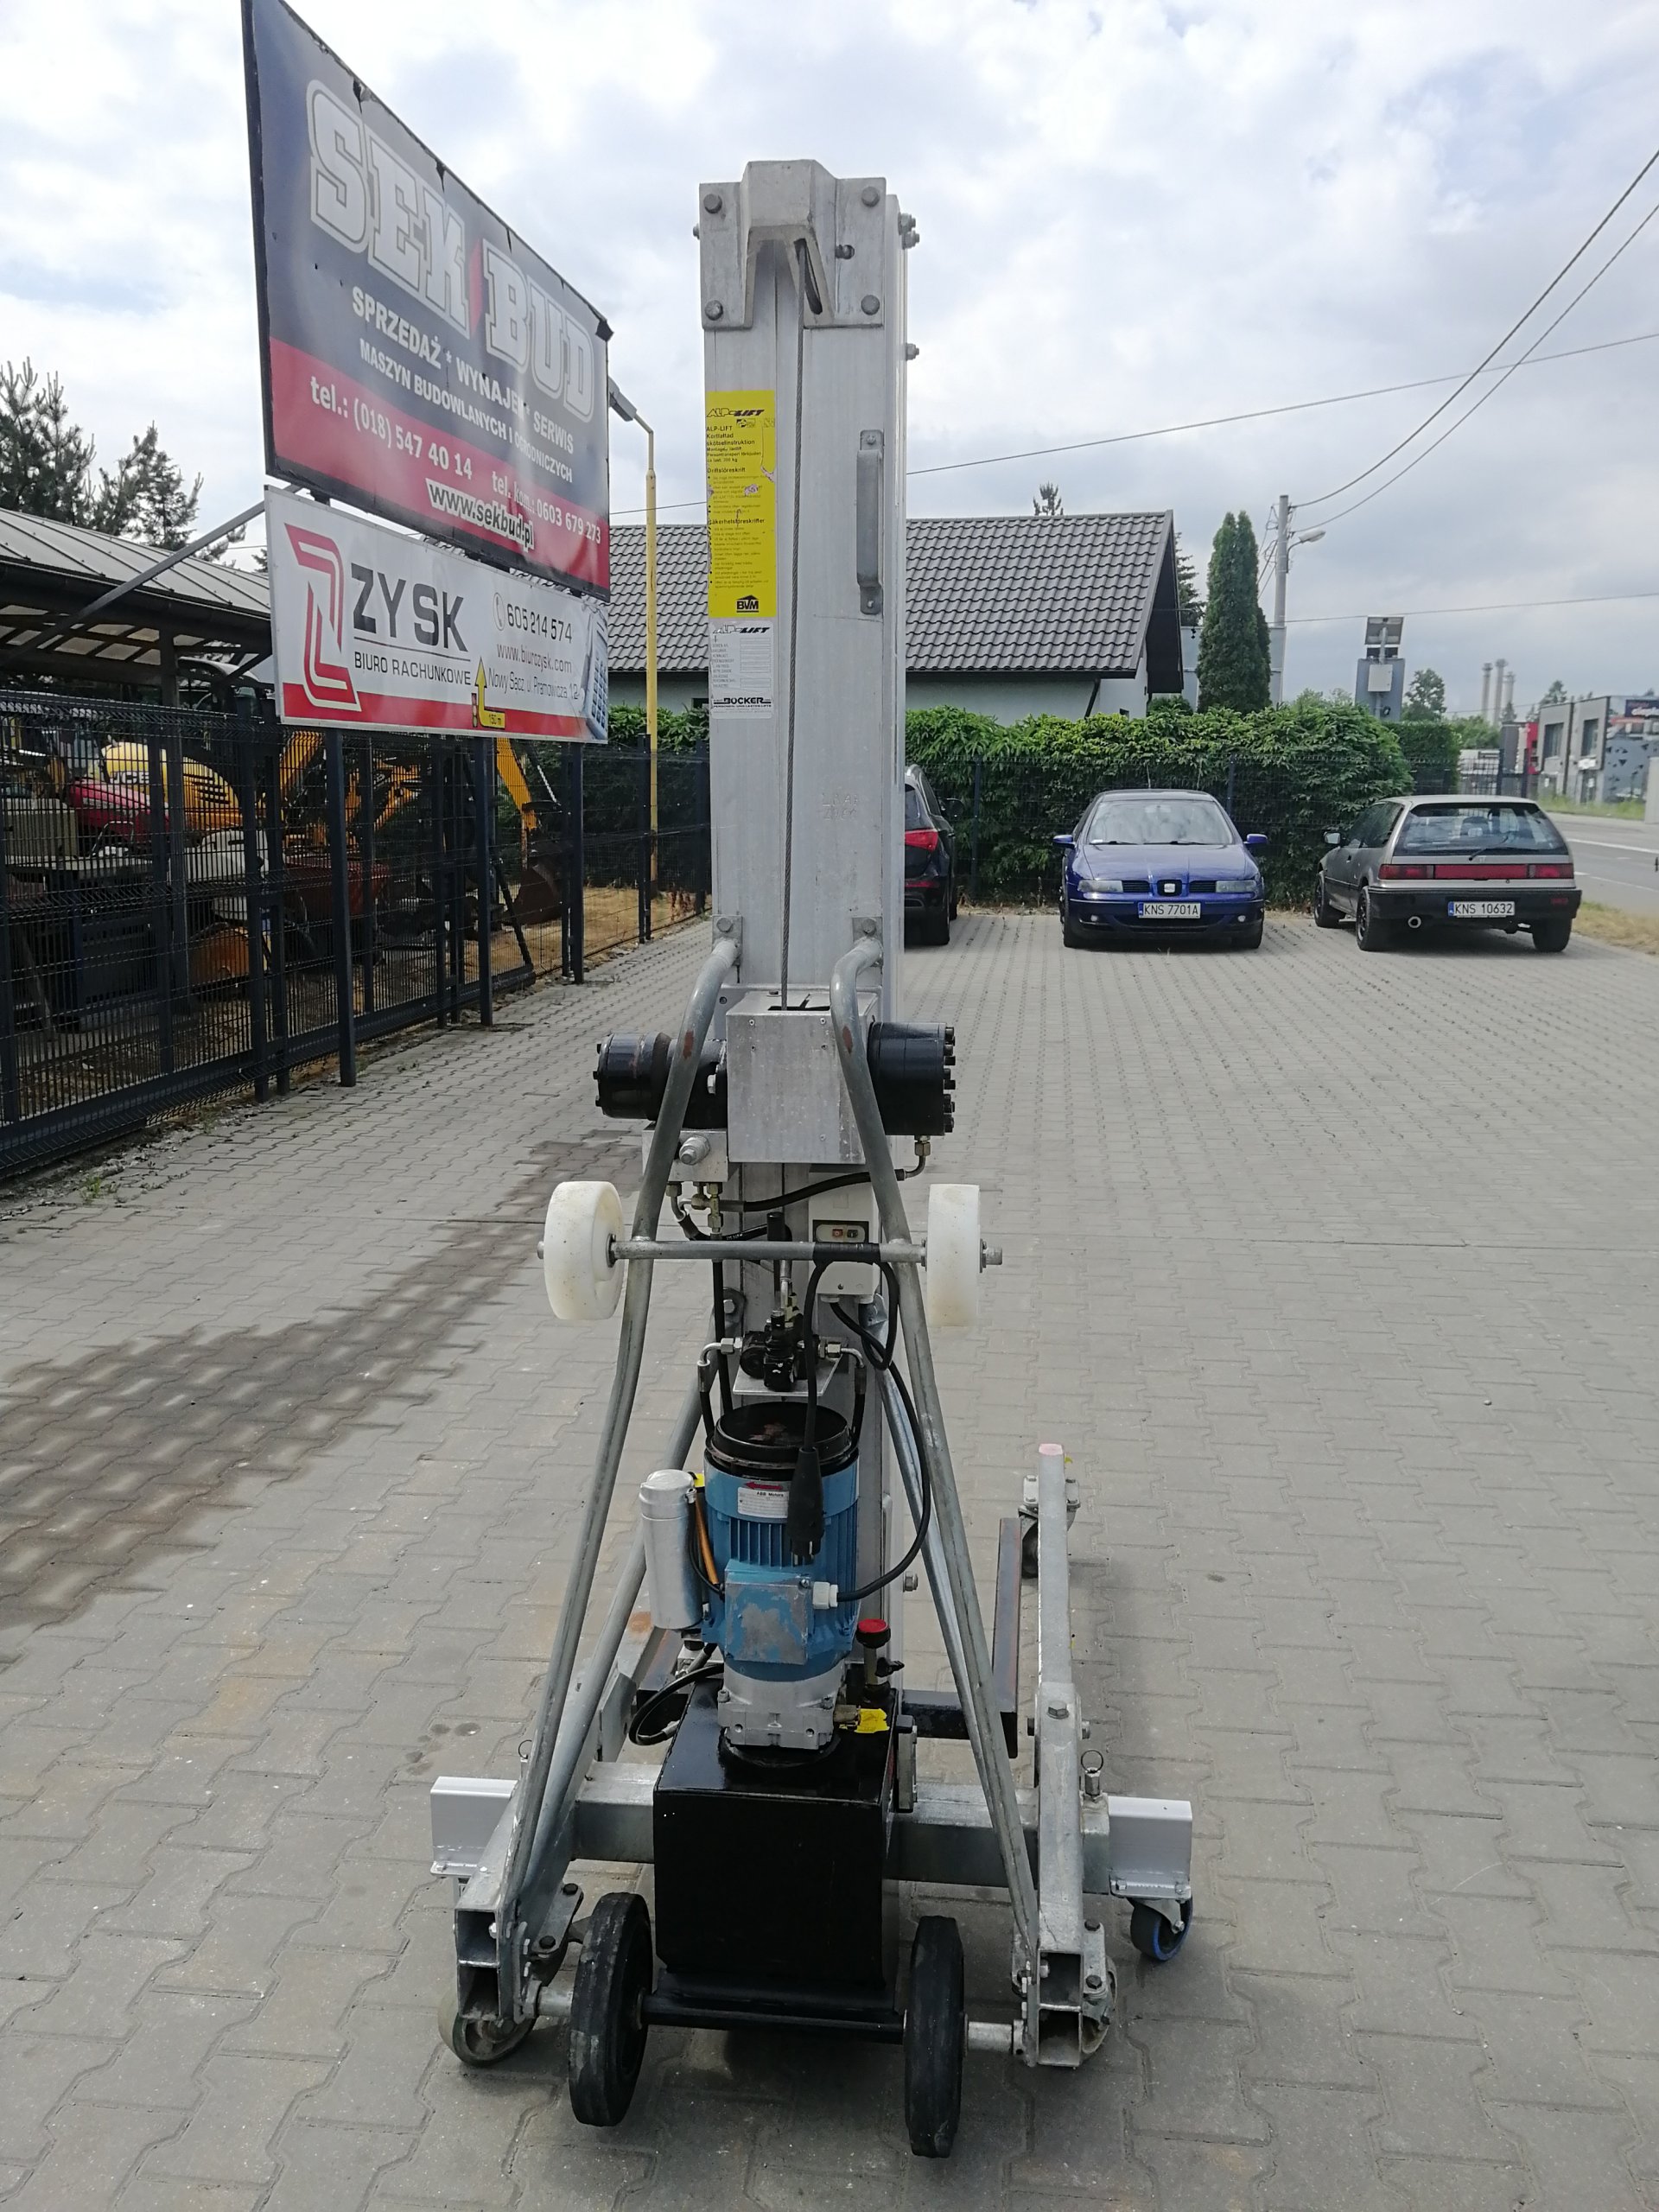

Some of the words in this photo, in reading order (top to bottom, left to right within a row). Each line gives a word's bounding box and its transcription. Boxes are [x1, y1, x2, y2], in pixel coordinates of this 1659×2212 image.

[306, 79, 471, 340] SEK
[482, 238, 594, 423] BUD
[353, 286, 442, 369] SPRZEDAŻ
[533, 411, 574, 454] SERWIS
[310, 376, 348, 417] tel.:
[353, 397, 391, 448] (018)
[396, 424, 423, 458] 547
[428, 442, 449, 470] 40
[454, 453, 473, 480] 14
[359, 338, 411, 390] MASZYN
[414, 374, 507, 441] BUDOWLANYCH
[508, 427, 512, 443] I
[514, 433, 573, 483] OGRODNICZYCH
[428, 482, 533, 550] www.sekbud.pl
[492, 471, 512, 499] tel.
[537, 499, 562, 526] 0603
[565, 512, 584, 536] 679
[586, 521, 601, 544] 273
[351, 563, 468, 652] ZYSK
[506, 603, 529, 631] 605
[531, 612, 548, 639] 214
[550, 619, 572, 644] 574
[736, 600, 759, 610] BVM
[354, 652, 388, 673] BIURO
[392, 659, 472, 685] RACHUNKOWE
[488, 667, 509, 694] Nowy
[1144, 905, 1165, 915] KNS
[1167, 905, 1198, 915] 7701A
[1455, 904, 1476, 914] KNS
[1481, 903, 1513, 914] 10632
